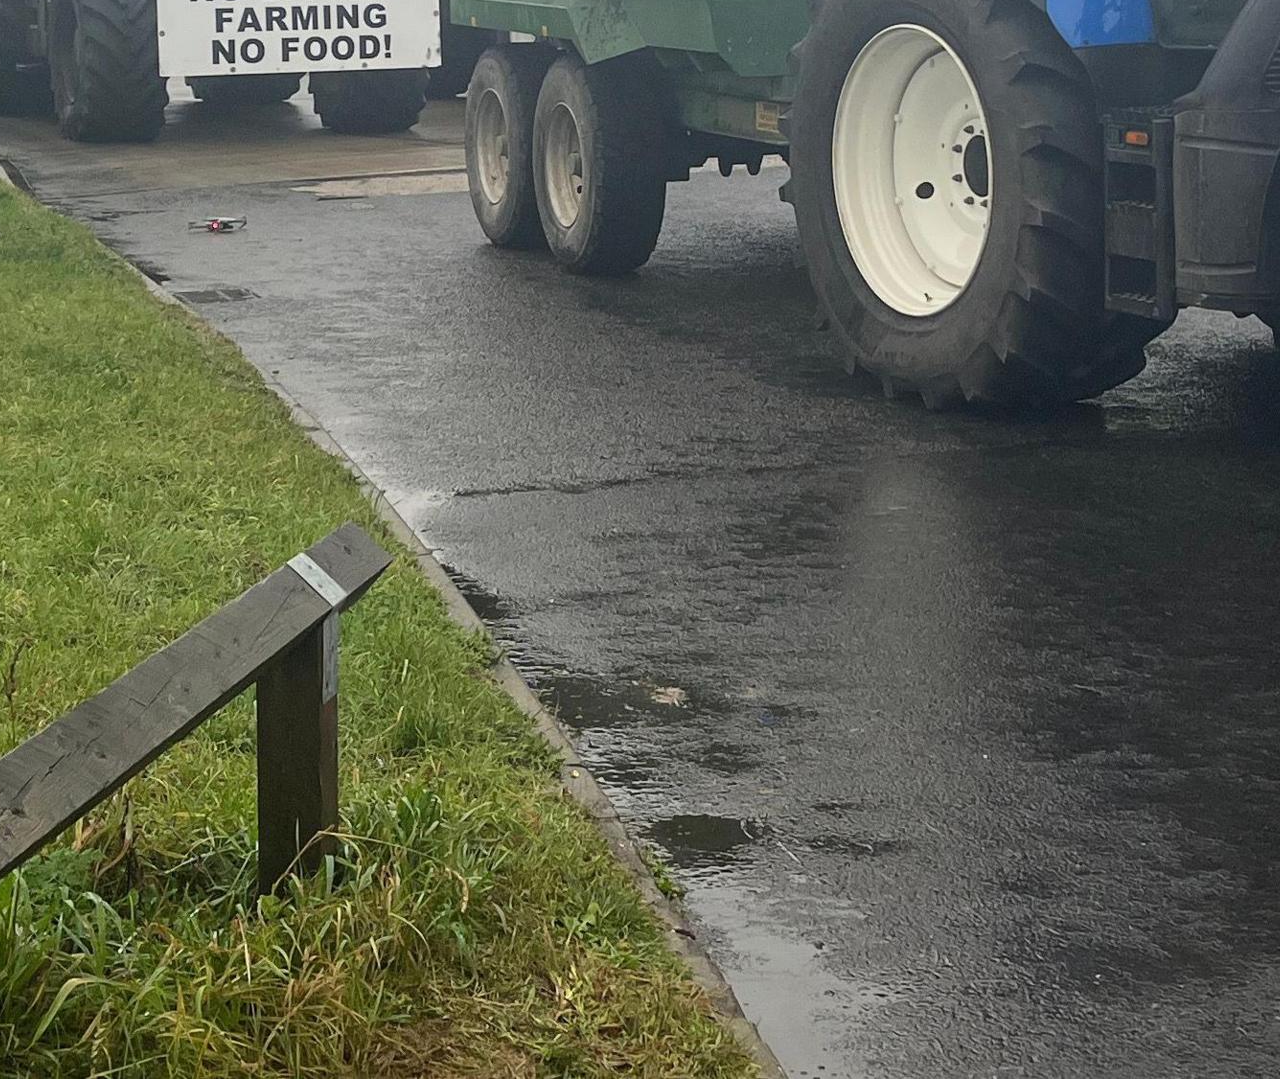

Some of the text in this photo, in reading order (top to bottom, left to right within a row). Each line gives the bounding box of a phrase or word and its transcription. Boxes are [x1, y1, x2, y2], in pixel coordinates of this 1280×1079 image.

[214, 3, 388, 33] FARMING
[211, 34, 392, 65] NO FOOD!
